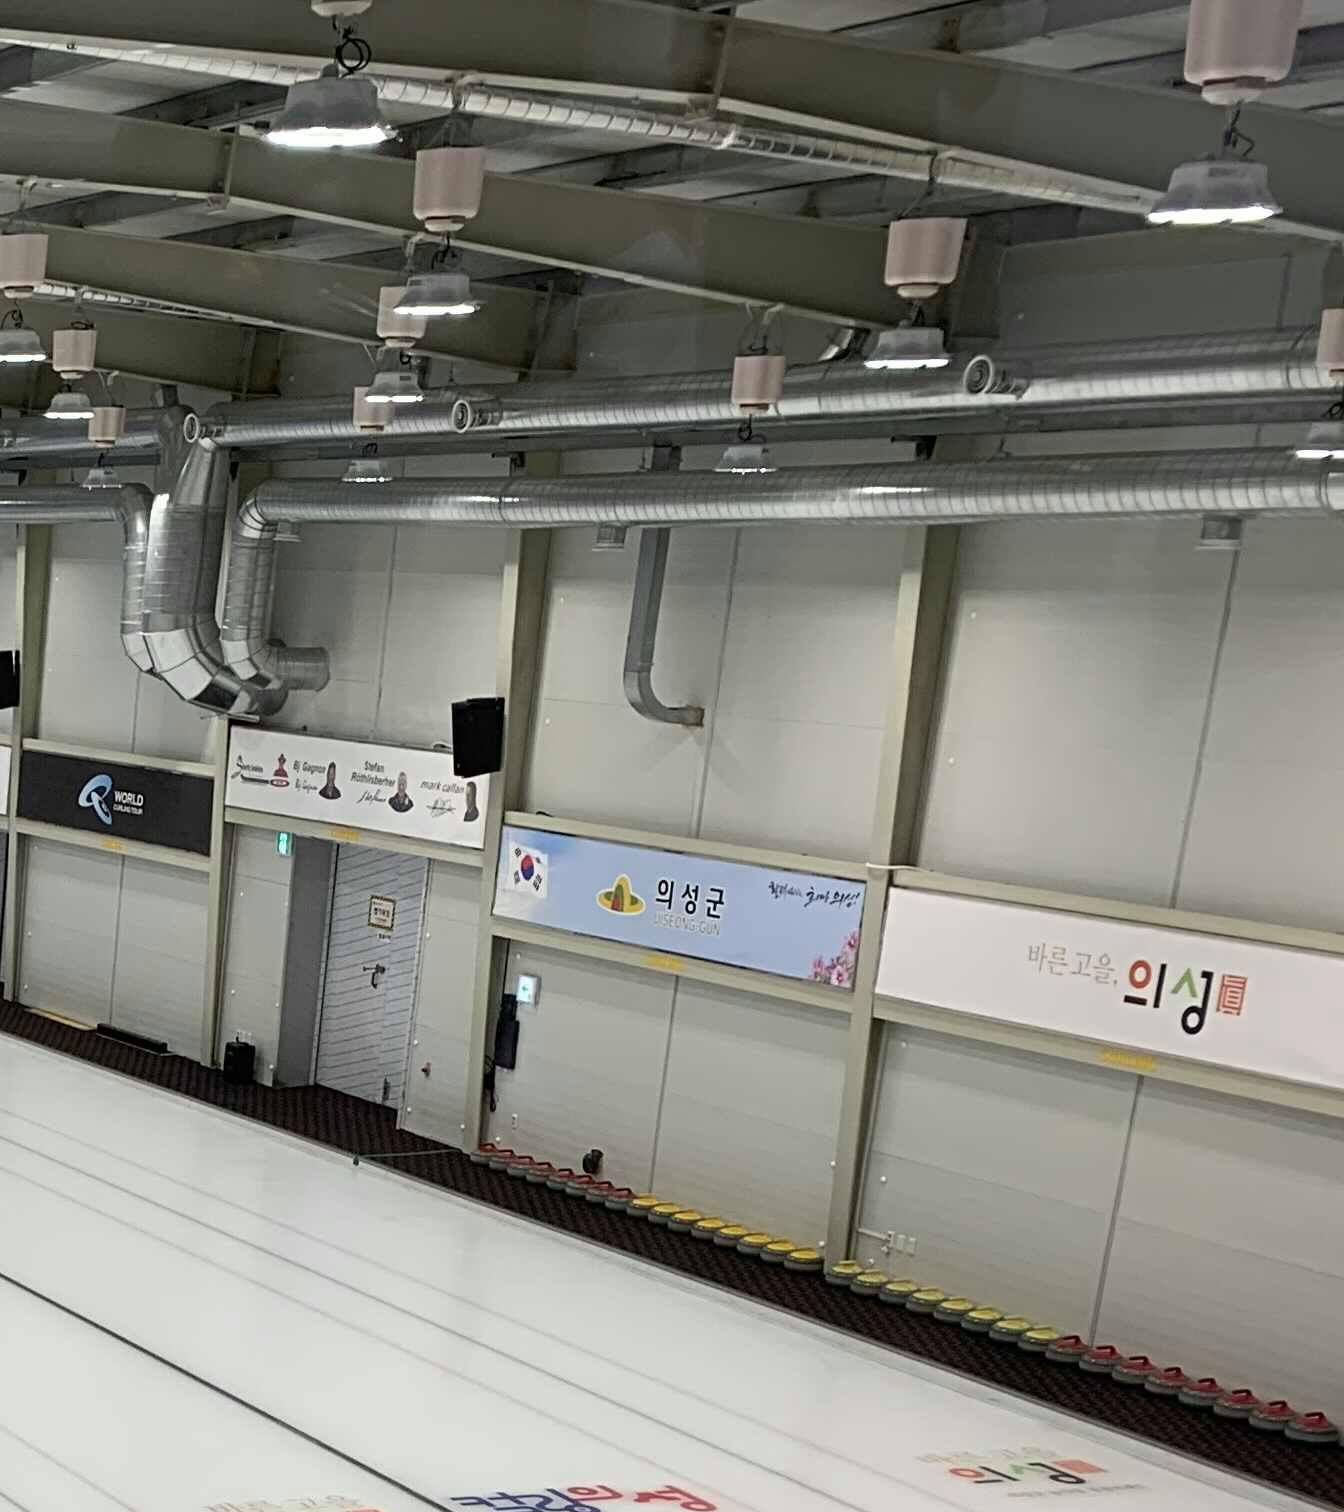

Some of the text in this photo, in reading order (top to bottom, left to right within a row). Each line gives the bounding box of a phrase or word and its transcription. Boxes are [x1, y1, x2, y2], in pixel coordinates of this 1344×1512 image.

[114, 790, 144, 806] WORLD
[655, 879, 725, 919] 의성군
[1123, 959, 1214, 1035] 의성
